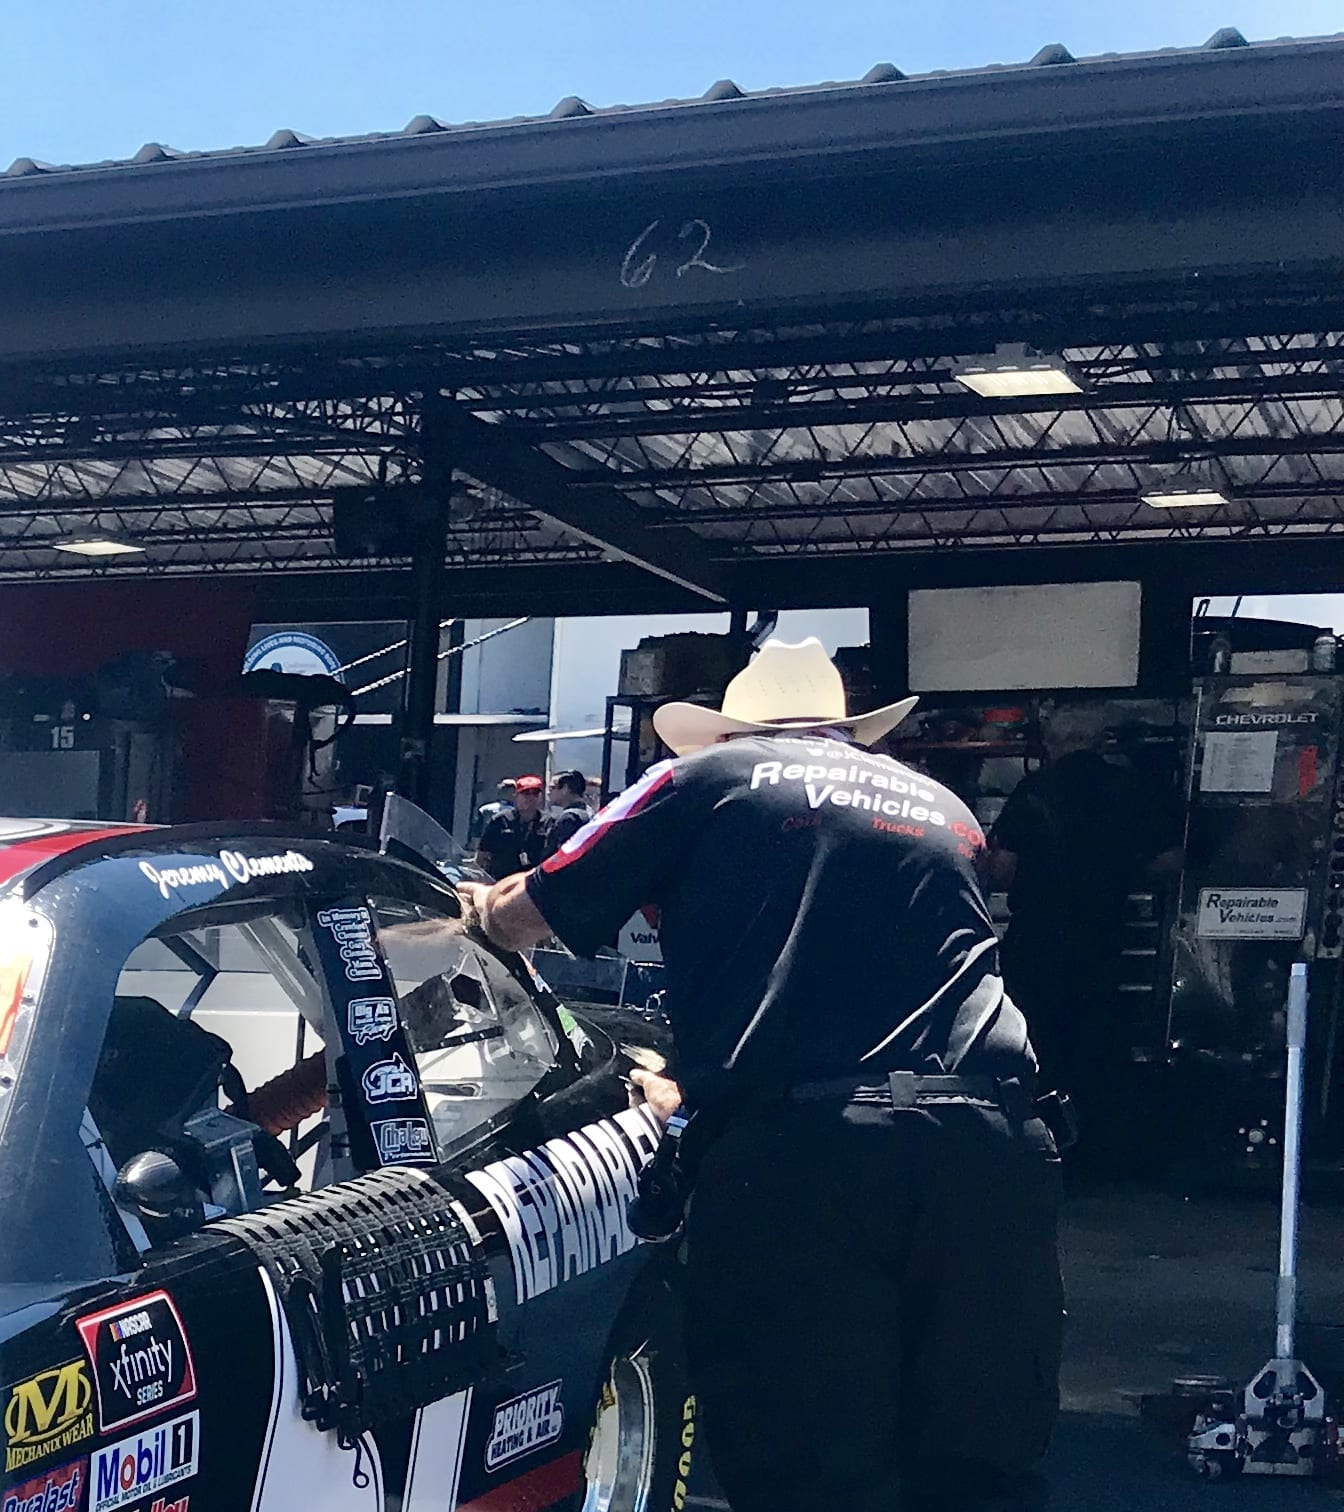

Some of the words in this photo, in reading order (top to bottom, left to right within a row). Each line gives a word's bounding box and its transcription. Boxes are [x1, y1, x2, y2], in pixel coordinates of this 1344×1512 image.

[620, 218, 738, 288] 62
[51, 725, 75, 749] 15
[1215, 712, 1320, 726] CHEVROLET
[750, 760, 937, 803] Repairable
[871, 816, 925, 839] Trucks
[138, 860, 231, 900] Jeremy
[219, 849, 315, 885] Clements
[1206, 893, 1279, 910] Repairable
[118, 1311, 153, 1338] NASCAR
[109, 1335, 172, 1399] xfinity
[136, 1380, 164, 1406] SERIES
[493, 1385, 560, 1439] PRIORITY
[5, 1437, 62, 1473] MECHANIX
[62, 1412, 95, 1444] WEAR
[490, 1433, 525, 1461] HEATING
[535, 1418, 551, 1439] AIR
[96, 1429, 166, 1502] Mobil
[177, 1424, 187, 1465] 1
[95, 1496, 121, 1512] OFFICIAL
[121, 1488, 142, 1504] MOTOR
[157, 1464, 192, 1489] LUBRICANTS
